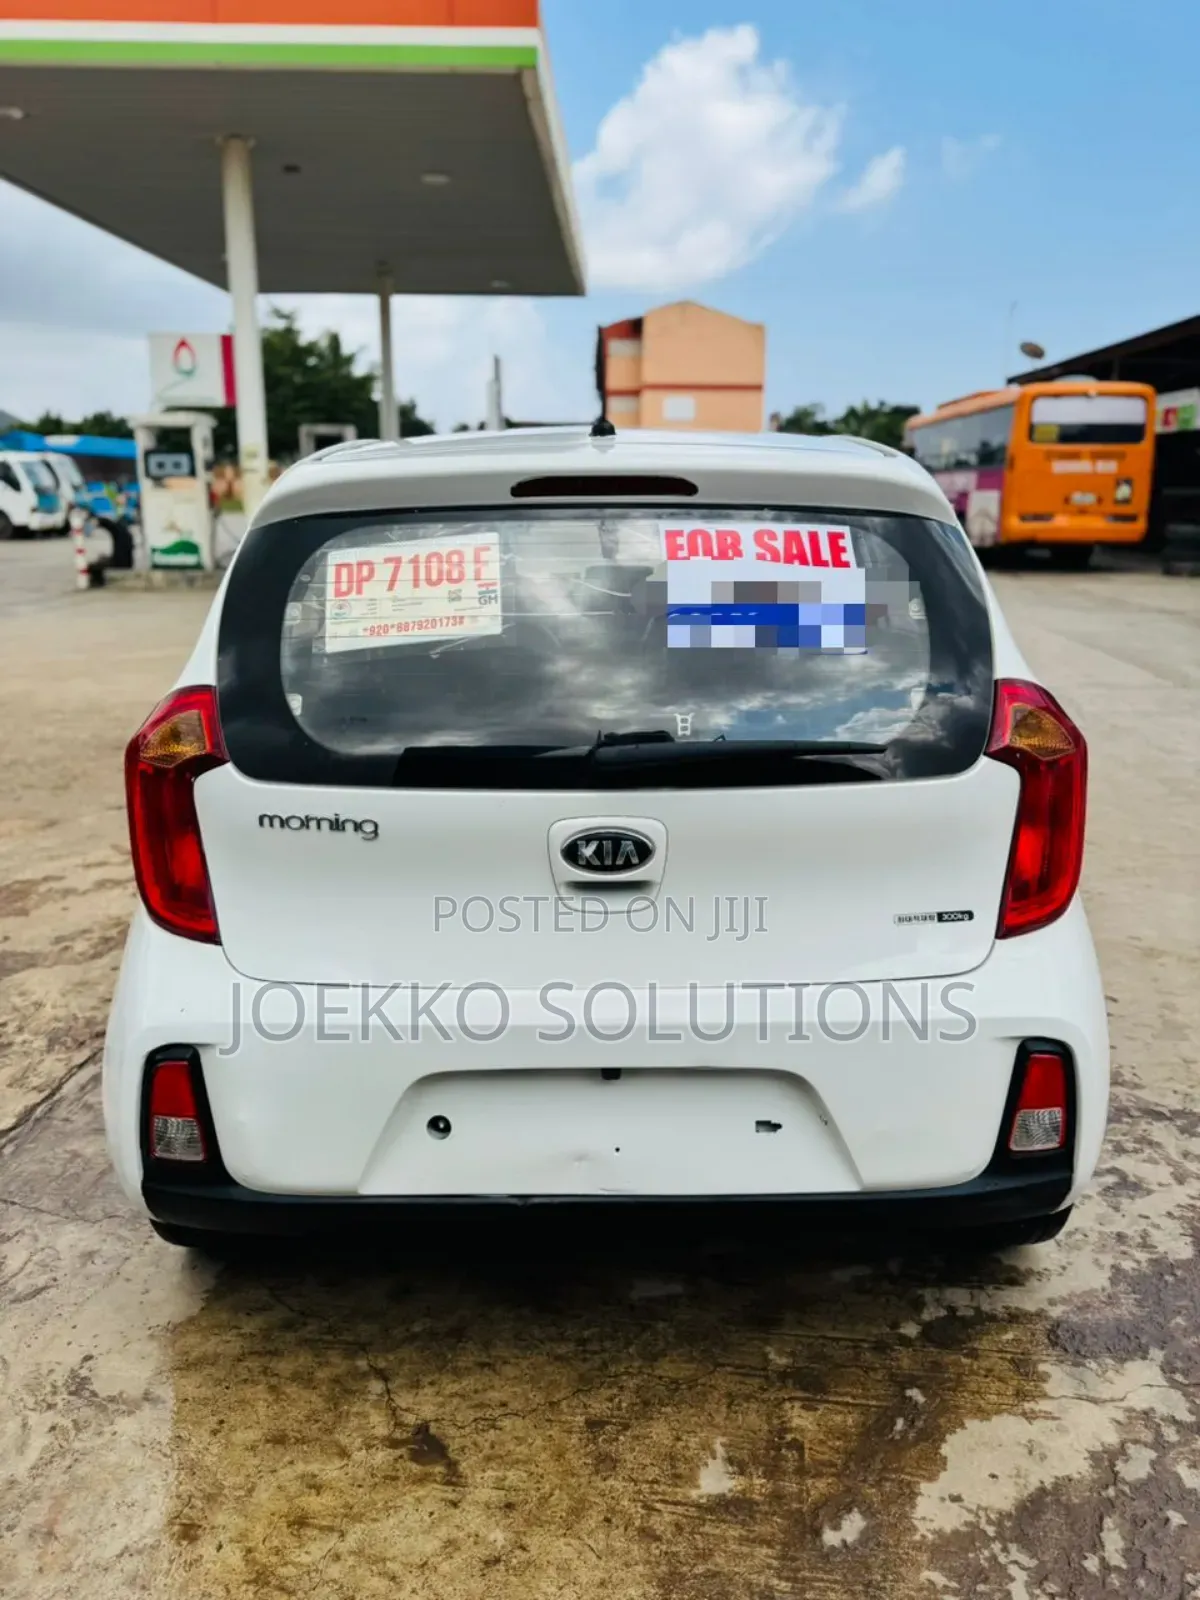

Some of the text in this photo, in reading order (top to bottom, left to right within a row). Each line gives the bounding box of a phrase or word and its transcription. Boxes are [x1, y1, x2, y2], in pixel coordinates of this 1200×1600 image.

[664, 529, 851, 568] FOR SALE
[334, 560, 376, 599] DP
[383, 550, 465, 592] 7108
[478, 594, 498, 606] GH
[258, 813, 379, 841] morning
[577, 840, 640, 866] KIA
